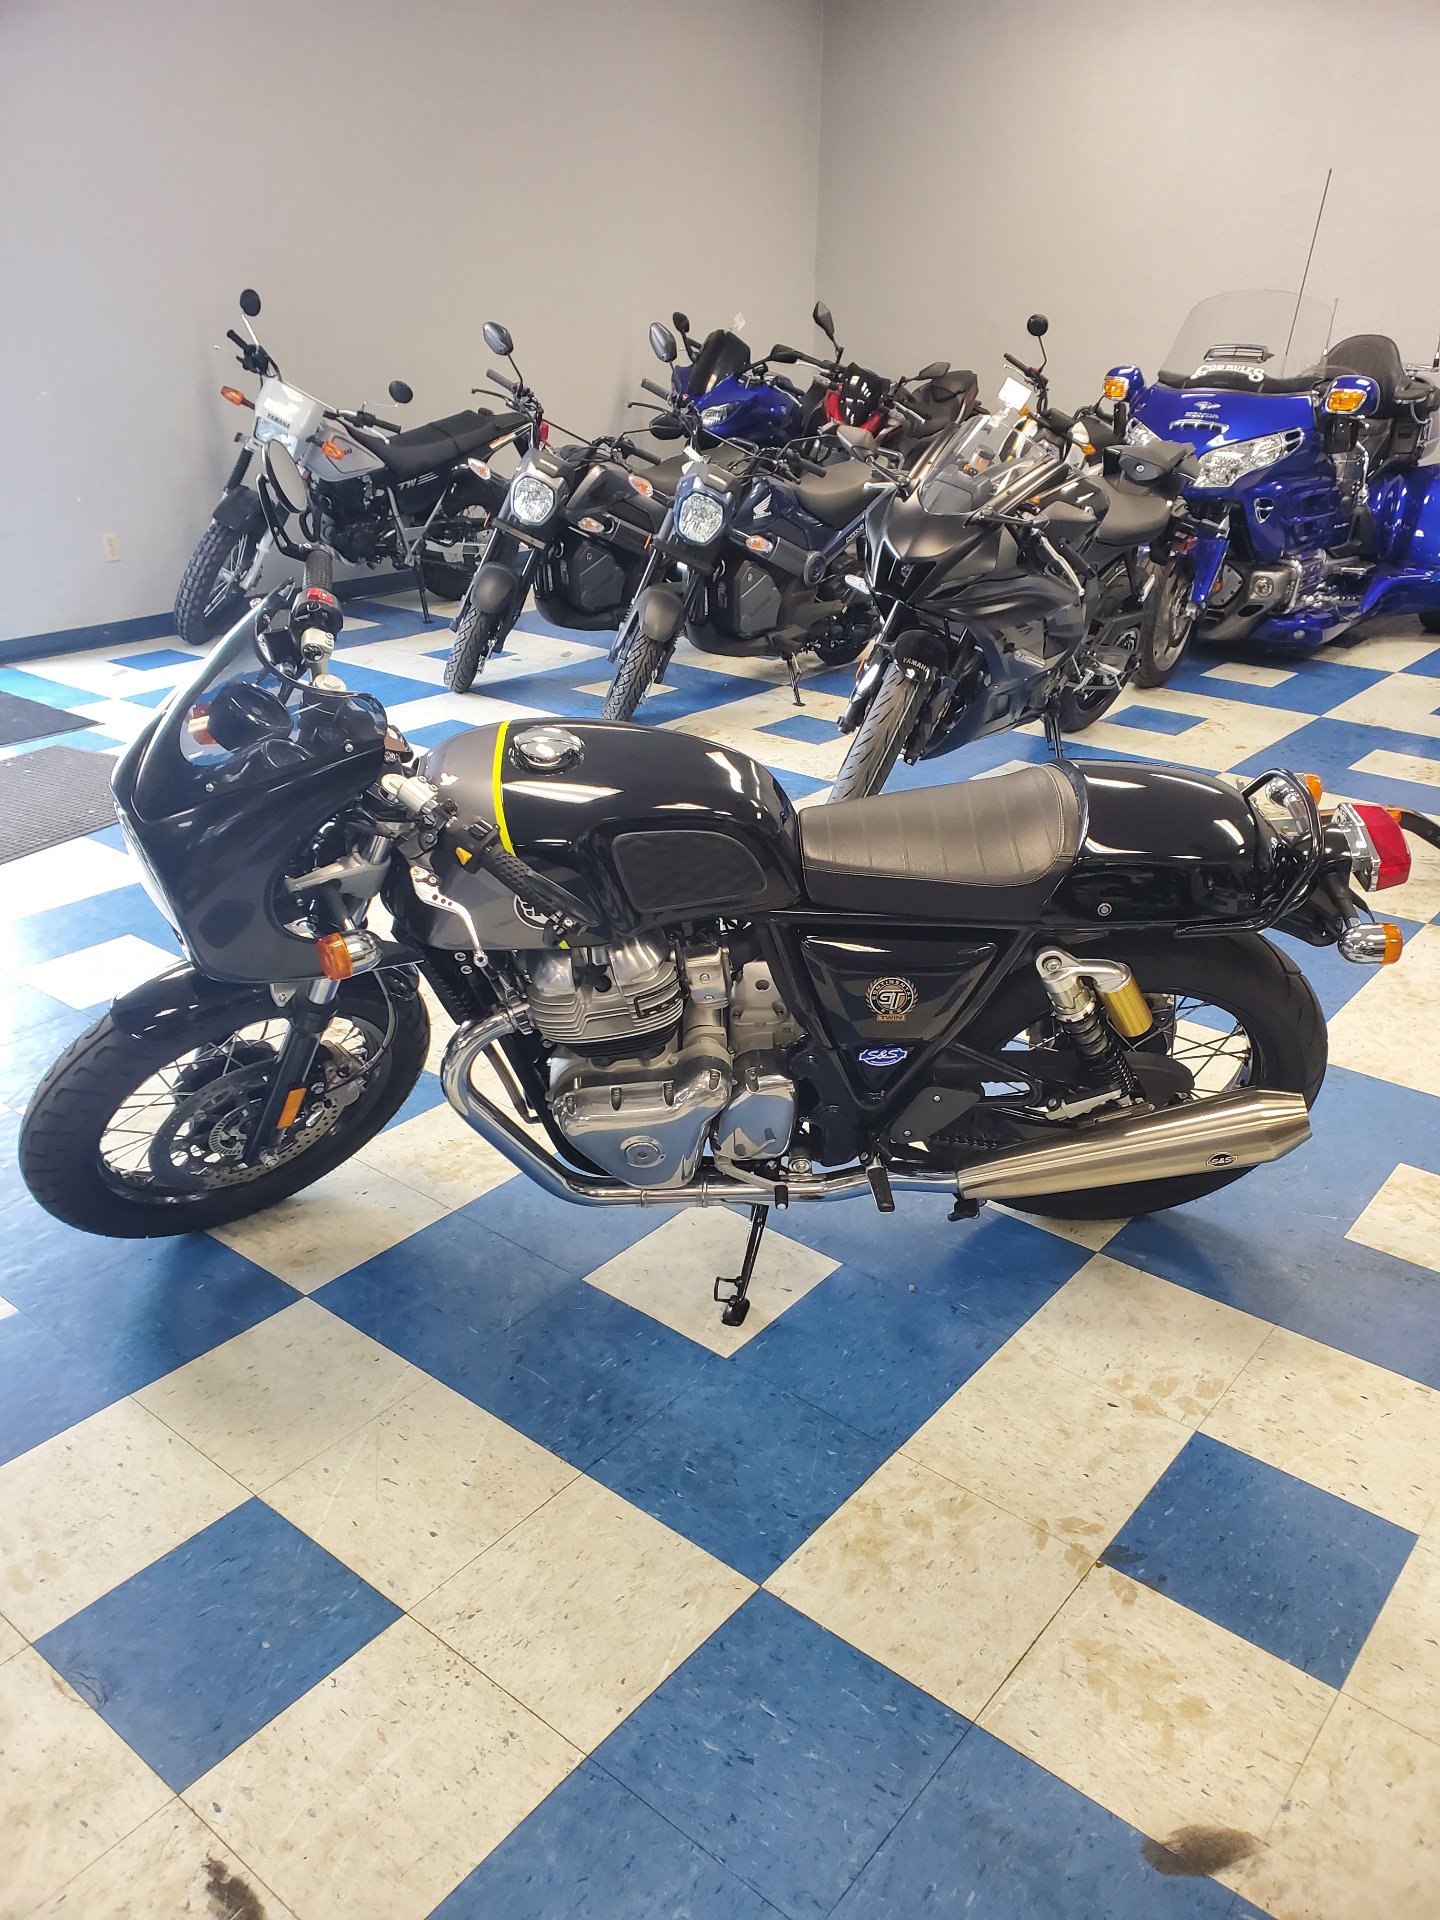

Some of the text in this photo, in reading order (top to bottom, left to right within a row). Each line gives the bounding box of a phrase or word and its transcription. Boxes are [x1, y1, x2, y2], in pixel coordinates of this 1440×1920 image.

[266, 412, 291, 429] YAMAHA
[902, 656, 931, 673] YAMAHA
[871, 979, 912, 1001] CONTINENTAL
[879, 989, 906, 1010] GT
[865, 1048, 899, 1060] S&S
[1211, 1156, 1232, 1165] S&S
